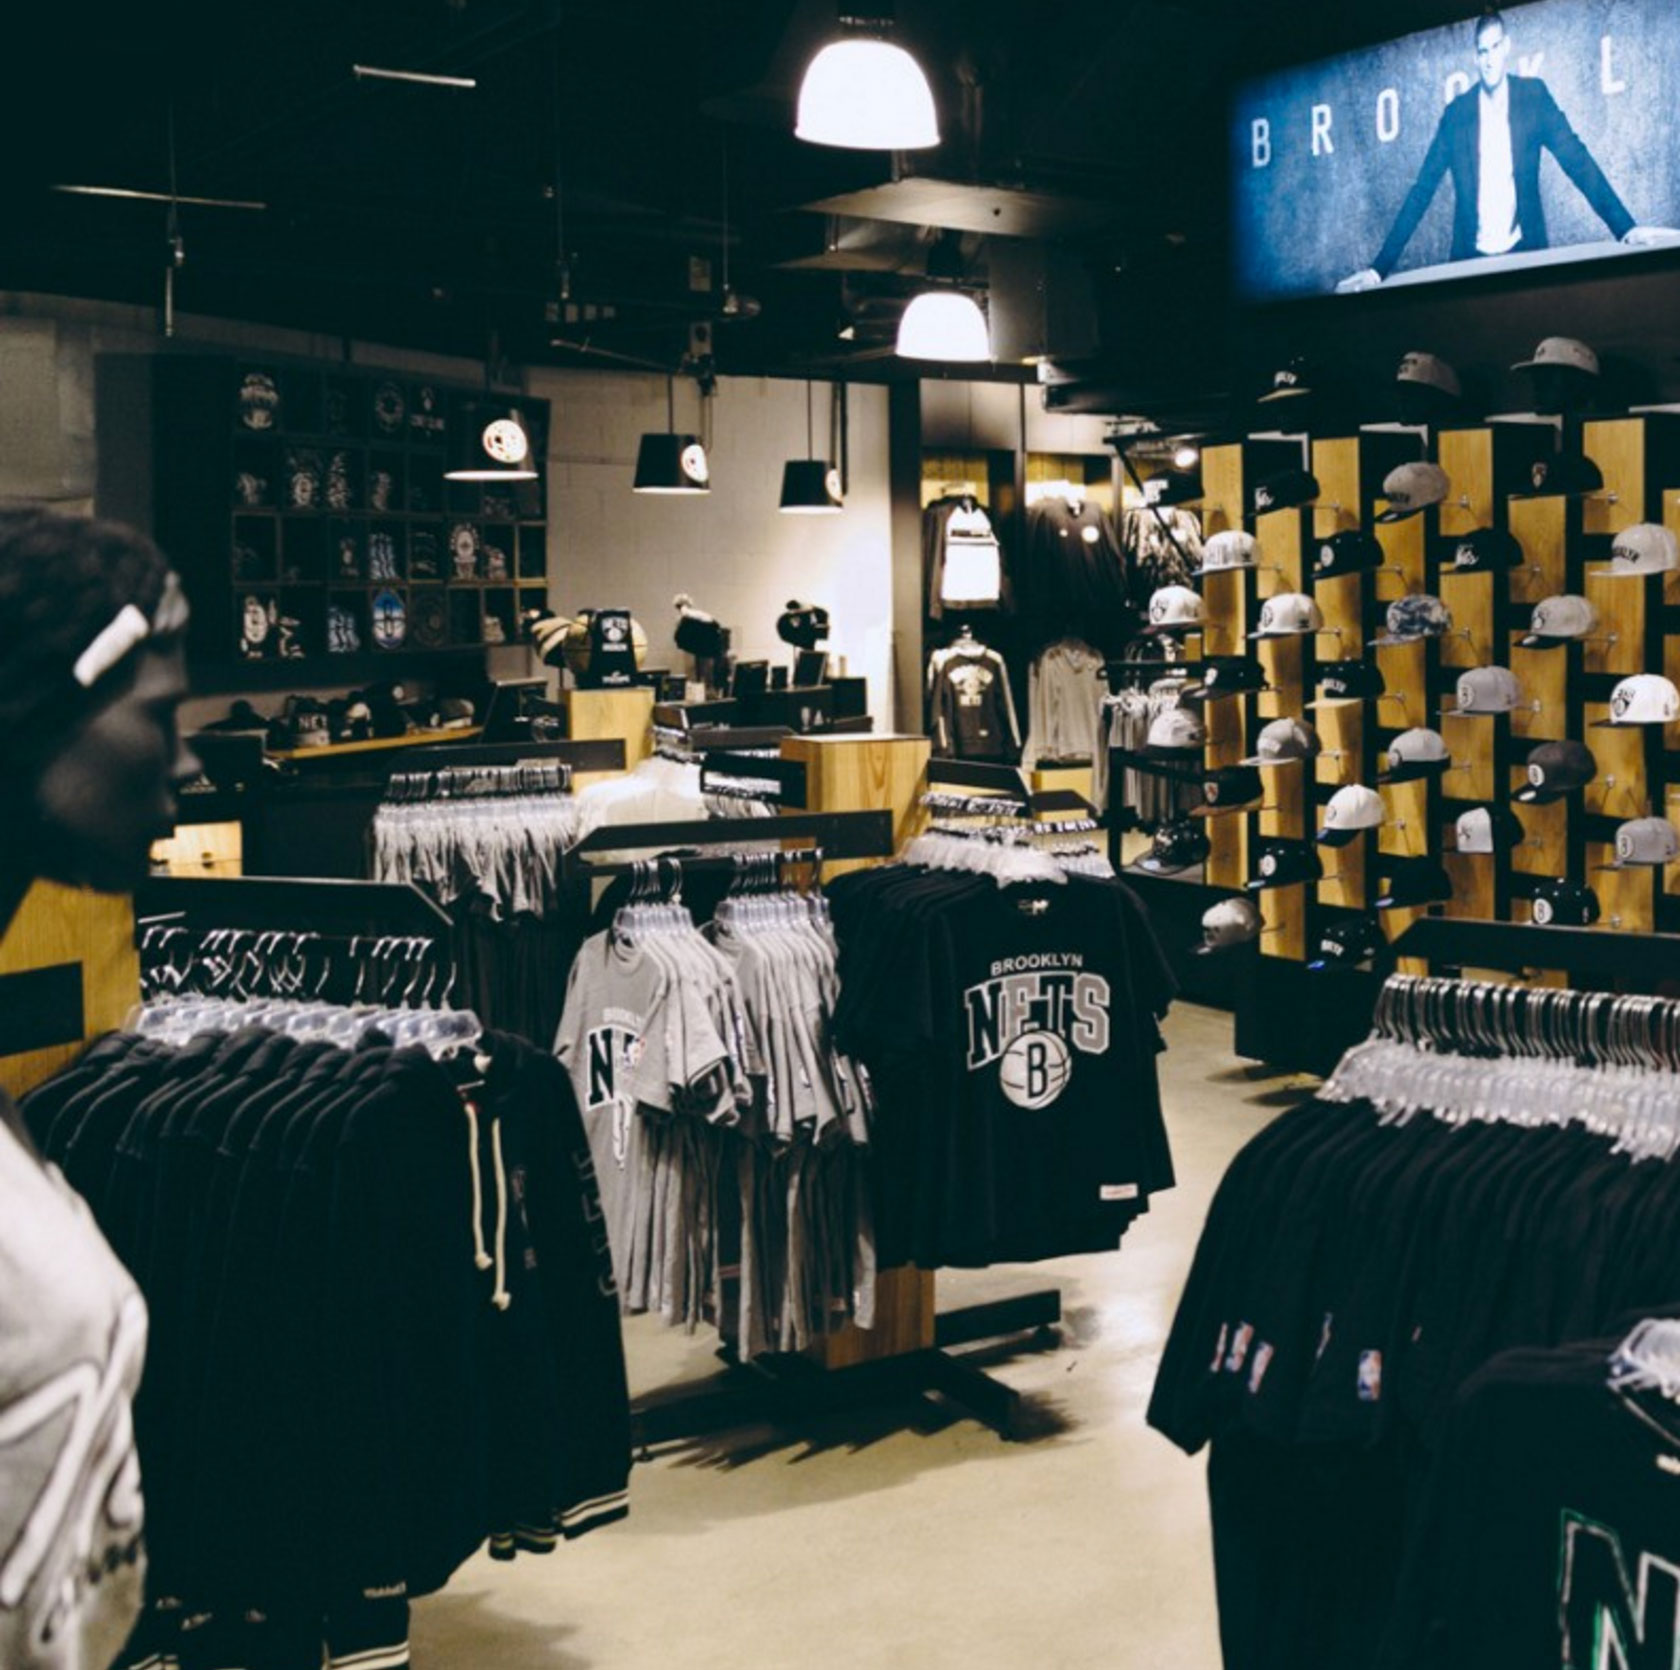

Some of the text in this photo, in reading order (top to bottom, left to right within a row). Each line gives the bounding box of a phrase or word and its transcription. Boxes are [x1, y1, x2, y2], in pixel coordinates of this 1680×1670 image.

[991, 953, 1083, 976] BROOKLYN
[964, 971, 1110, 1071] NETS
[1027, 1042, 1048, 1099] B
